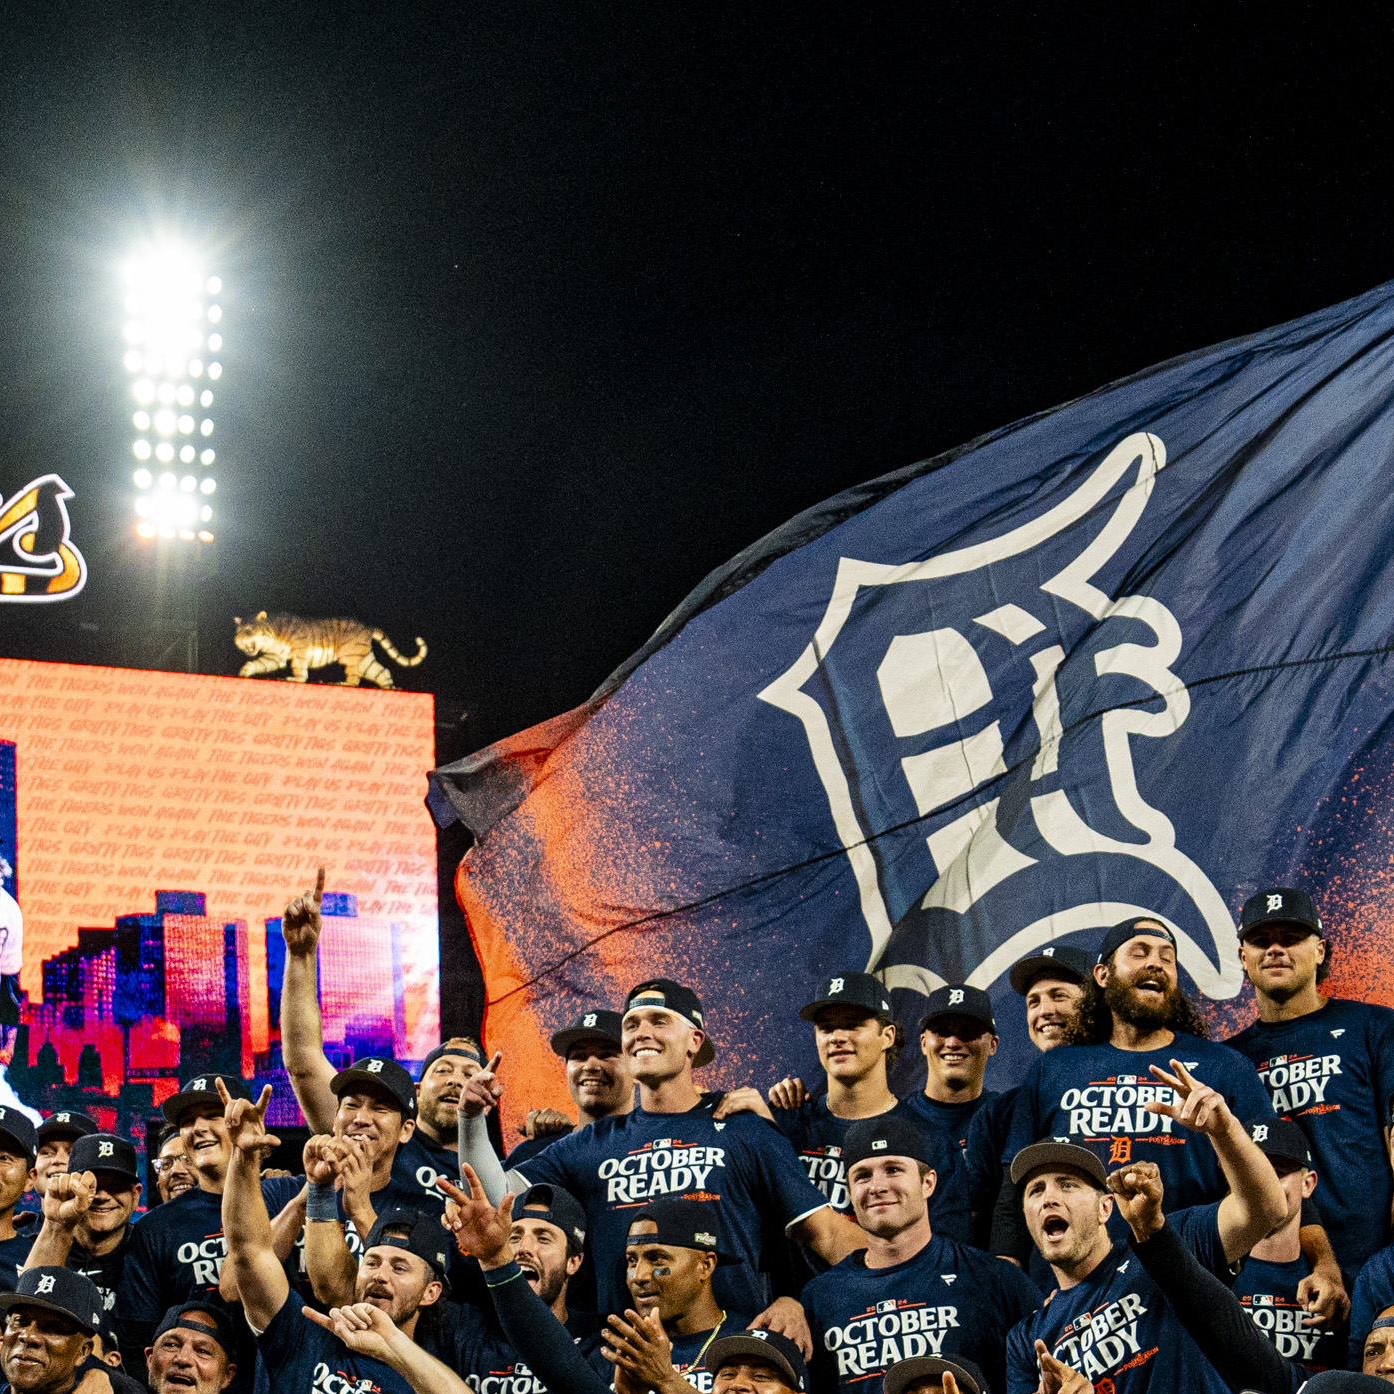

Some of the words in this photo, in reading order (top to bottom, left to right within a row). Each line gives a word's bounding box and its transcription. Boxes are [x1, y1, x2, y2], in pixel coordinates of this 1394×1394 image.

[1258, 1054, 1342, 1088] TOBER
[1272, 1076, 1329, 1113] ADY
[1070, 1107, 1174, 1136] READY
[598, 1147, 725, 1180] OCTOBER
[607, 1166, 713, 1203] READY
[824, 1306, 960, 1352] OCTOBER
[1053, 1293, 1147, 1364] CTOBER
[839, 1329, 948, 1376] READY
